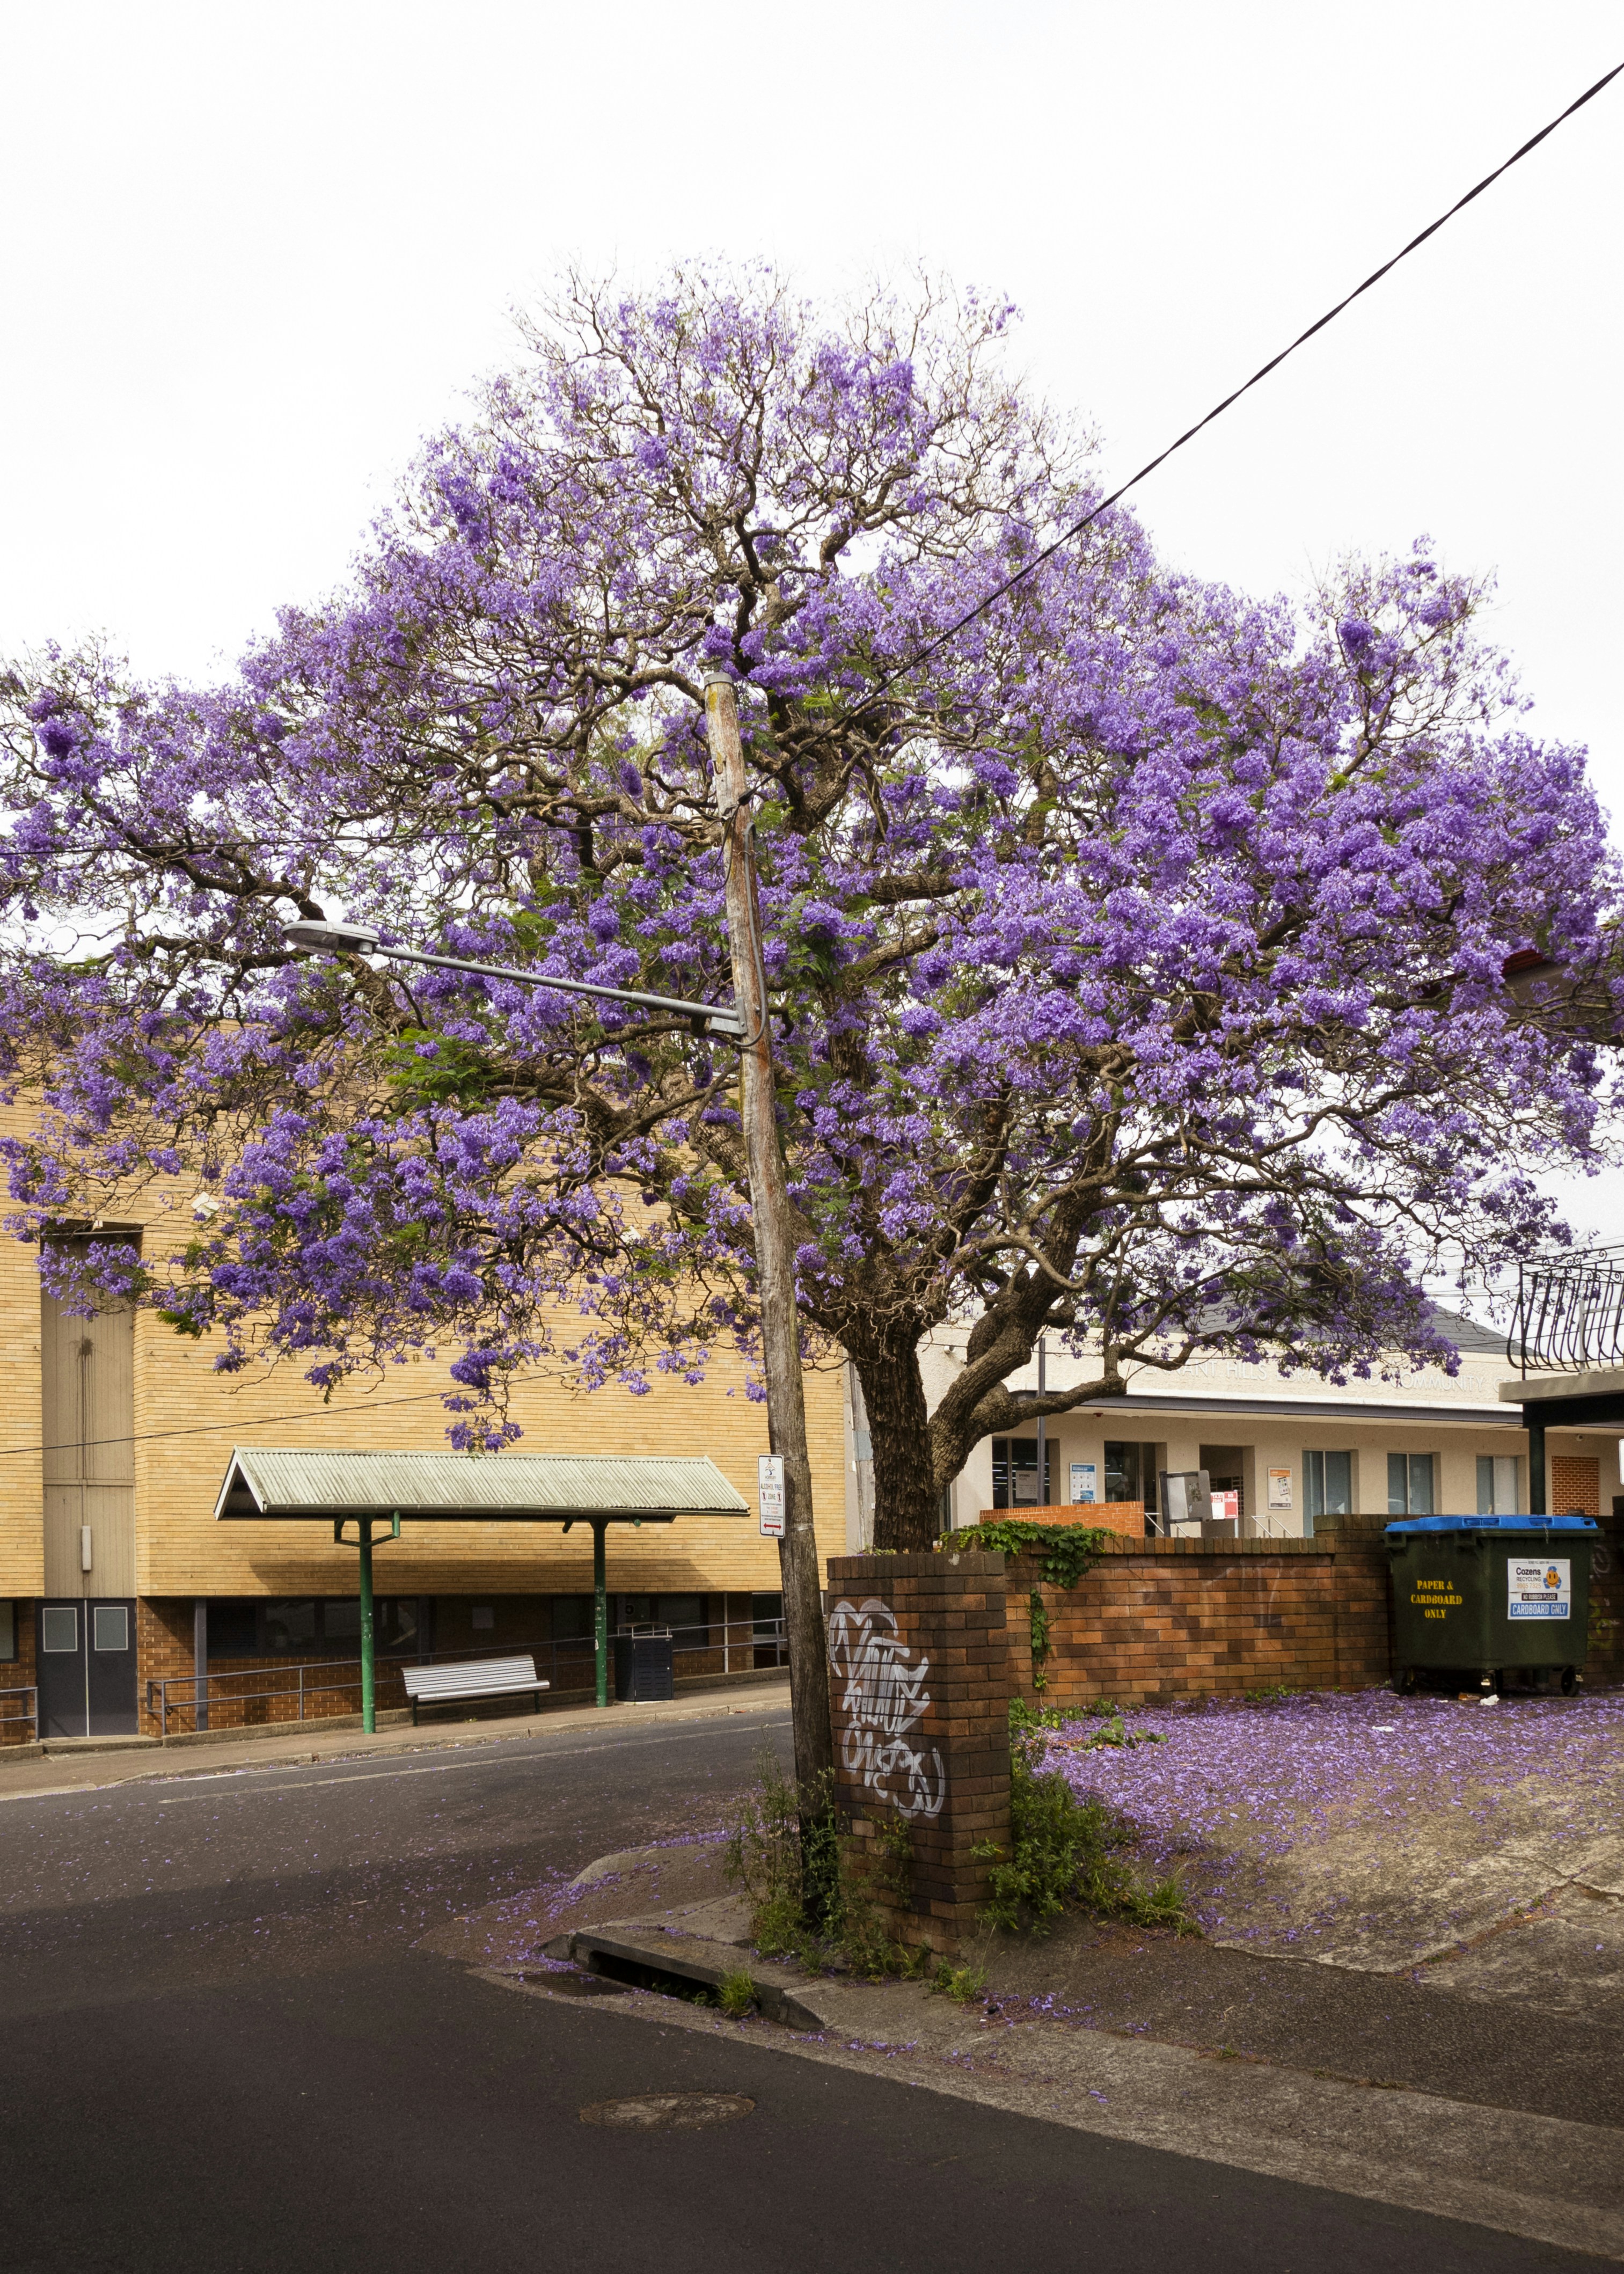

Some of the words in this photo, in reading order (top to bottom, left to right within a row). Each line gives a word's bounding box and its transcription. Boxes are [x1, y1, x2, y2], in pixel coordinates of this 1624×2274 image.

[1226, 1360, 1267, 1381] HILLS
[1390, 1372, 1483, 1392] COMMUNITY
[1516, 1567, 1541, 1575] Cozens
[1417, 1580, 1445, 1590] PAPER
[1446, 1581, 1453, 1590] &
[1410, 1594, 1462, 1605] CARDBOARD
[1424, 1608, 1446, 1619] ONLY
[1513, 1604, 1549, 1615] CARDBOARD
[1550, 1604, 1567, 1614] ONLY
